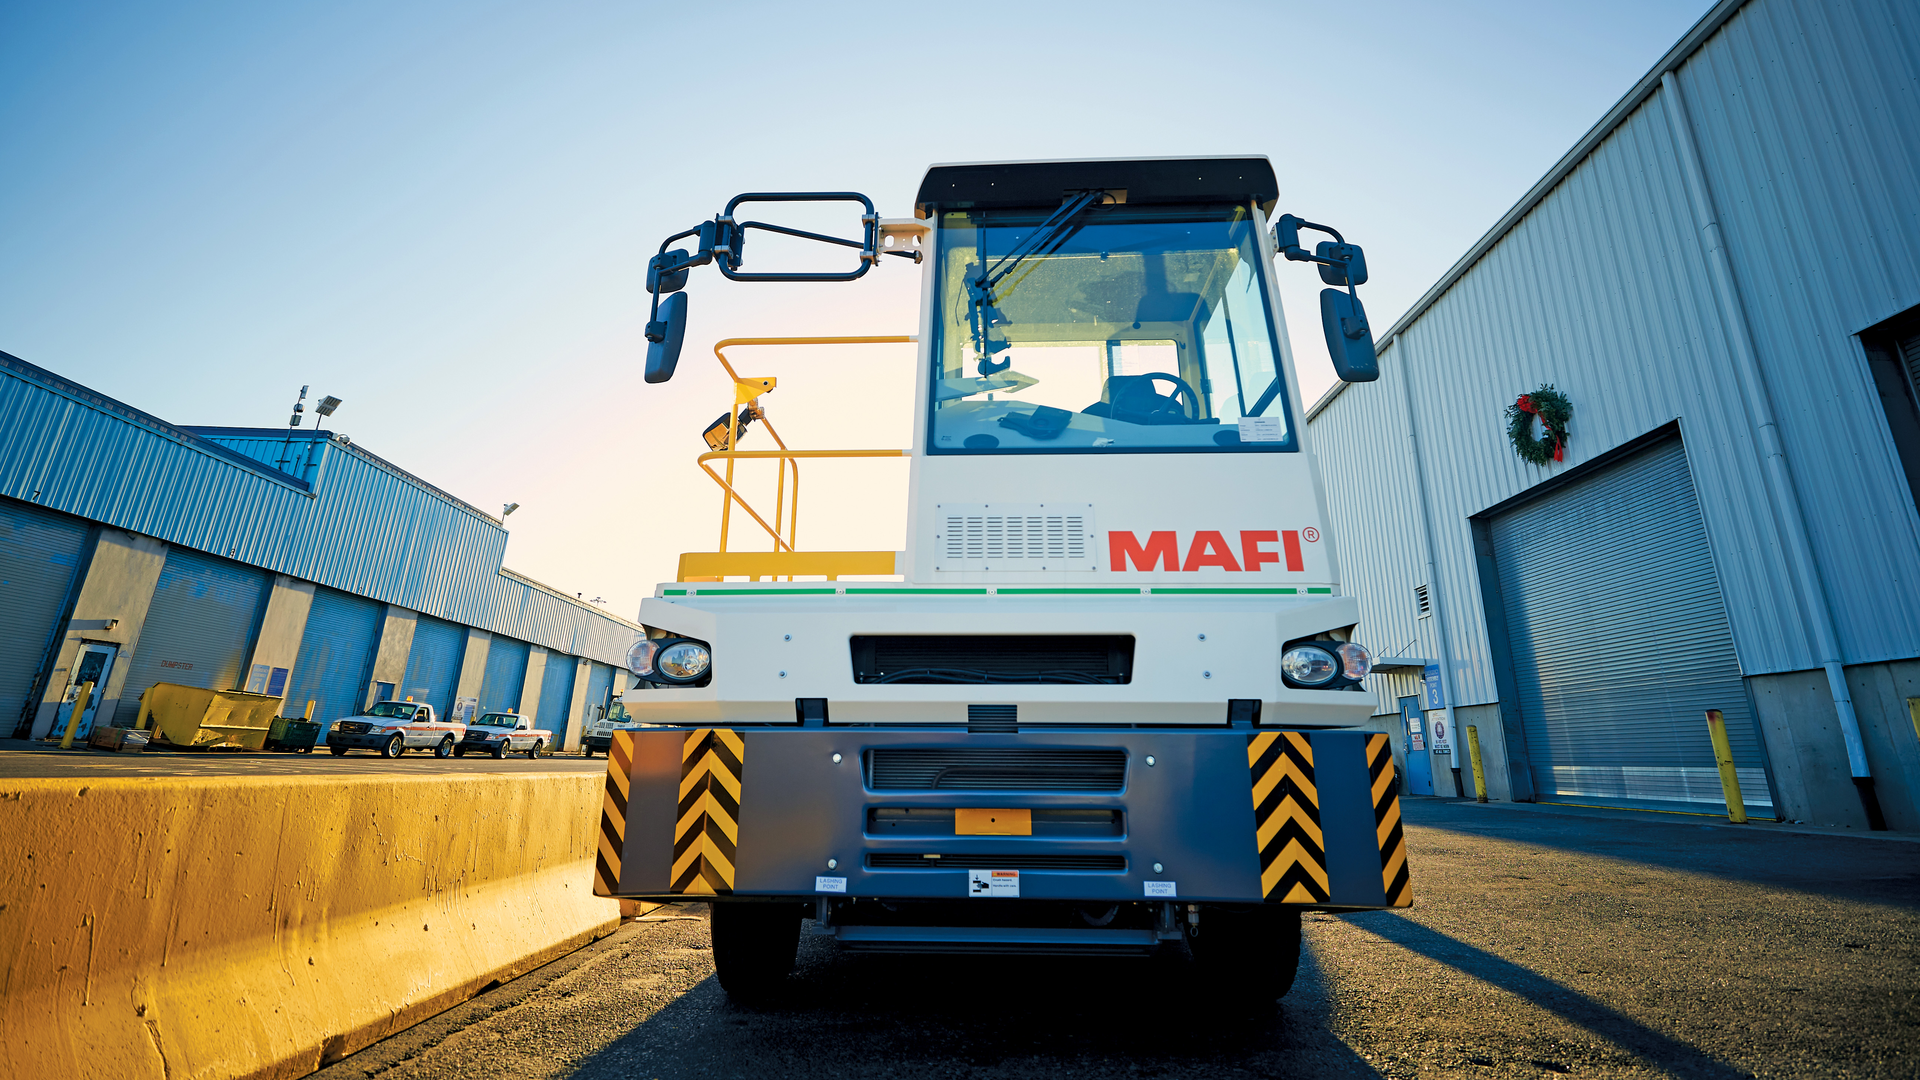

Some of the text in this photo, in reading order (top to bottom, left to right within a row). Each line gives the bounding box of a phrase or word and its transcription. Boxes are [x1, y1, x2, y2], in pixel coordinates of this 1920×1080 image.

[160, 659, 194, 670] DUMPSTER
[253, 683, 260, 693] 4
[1432, 689, 1438, 704] 3
